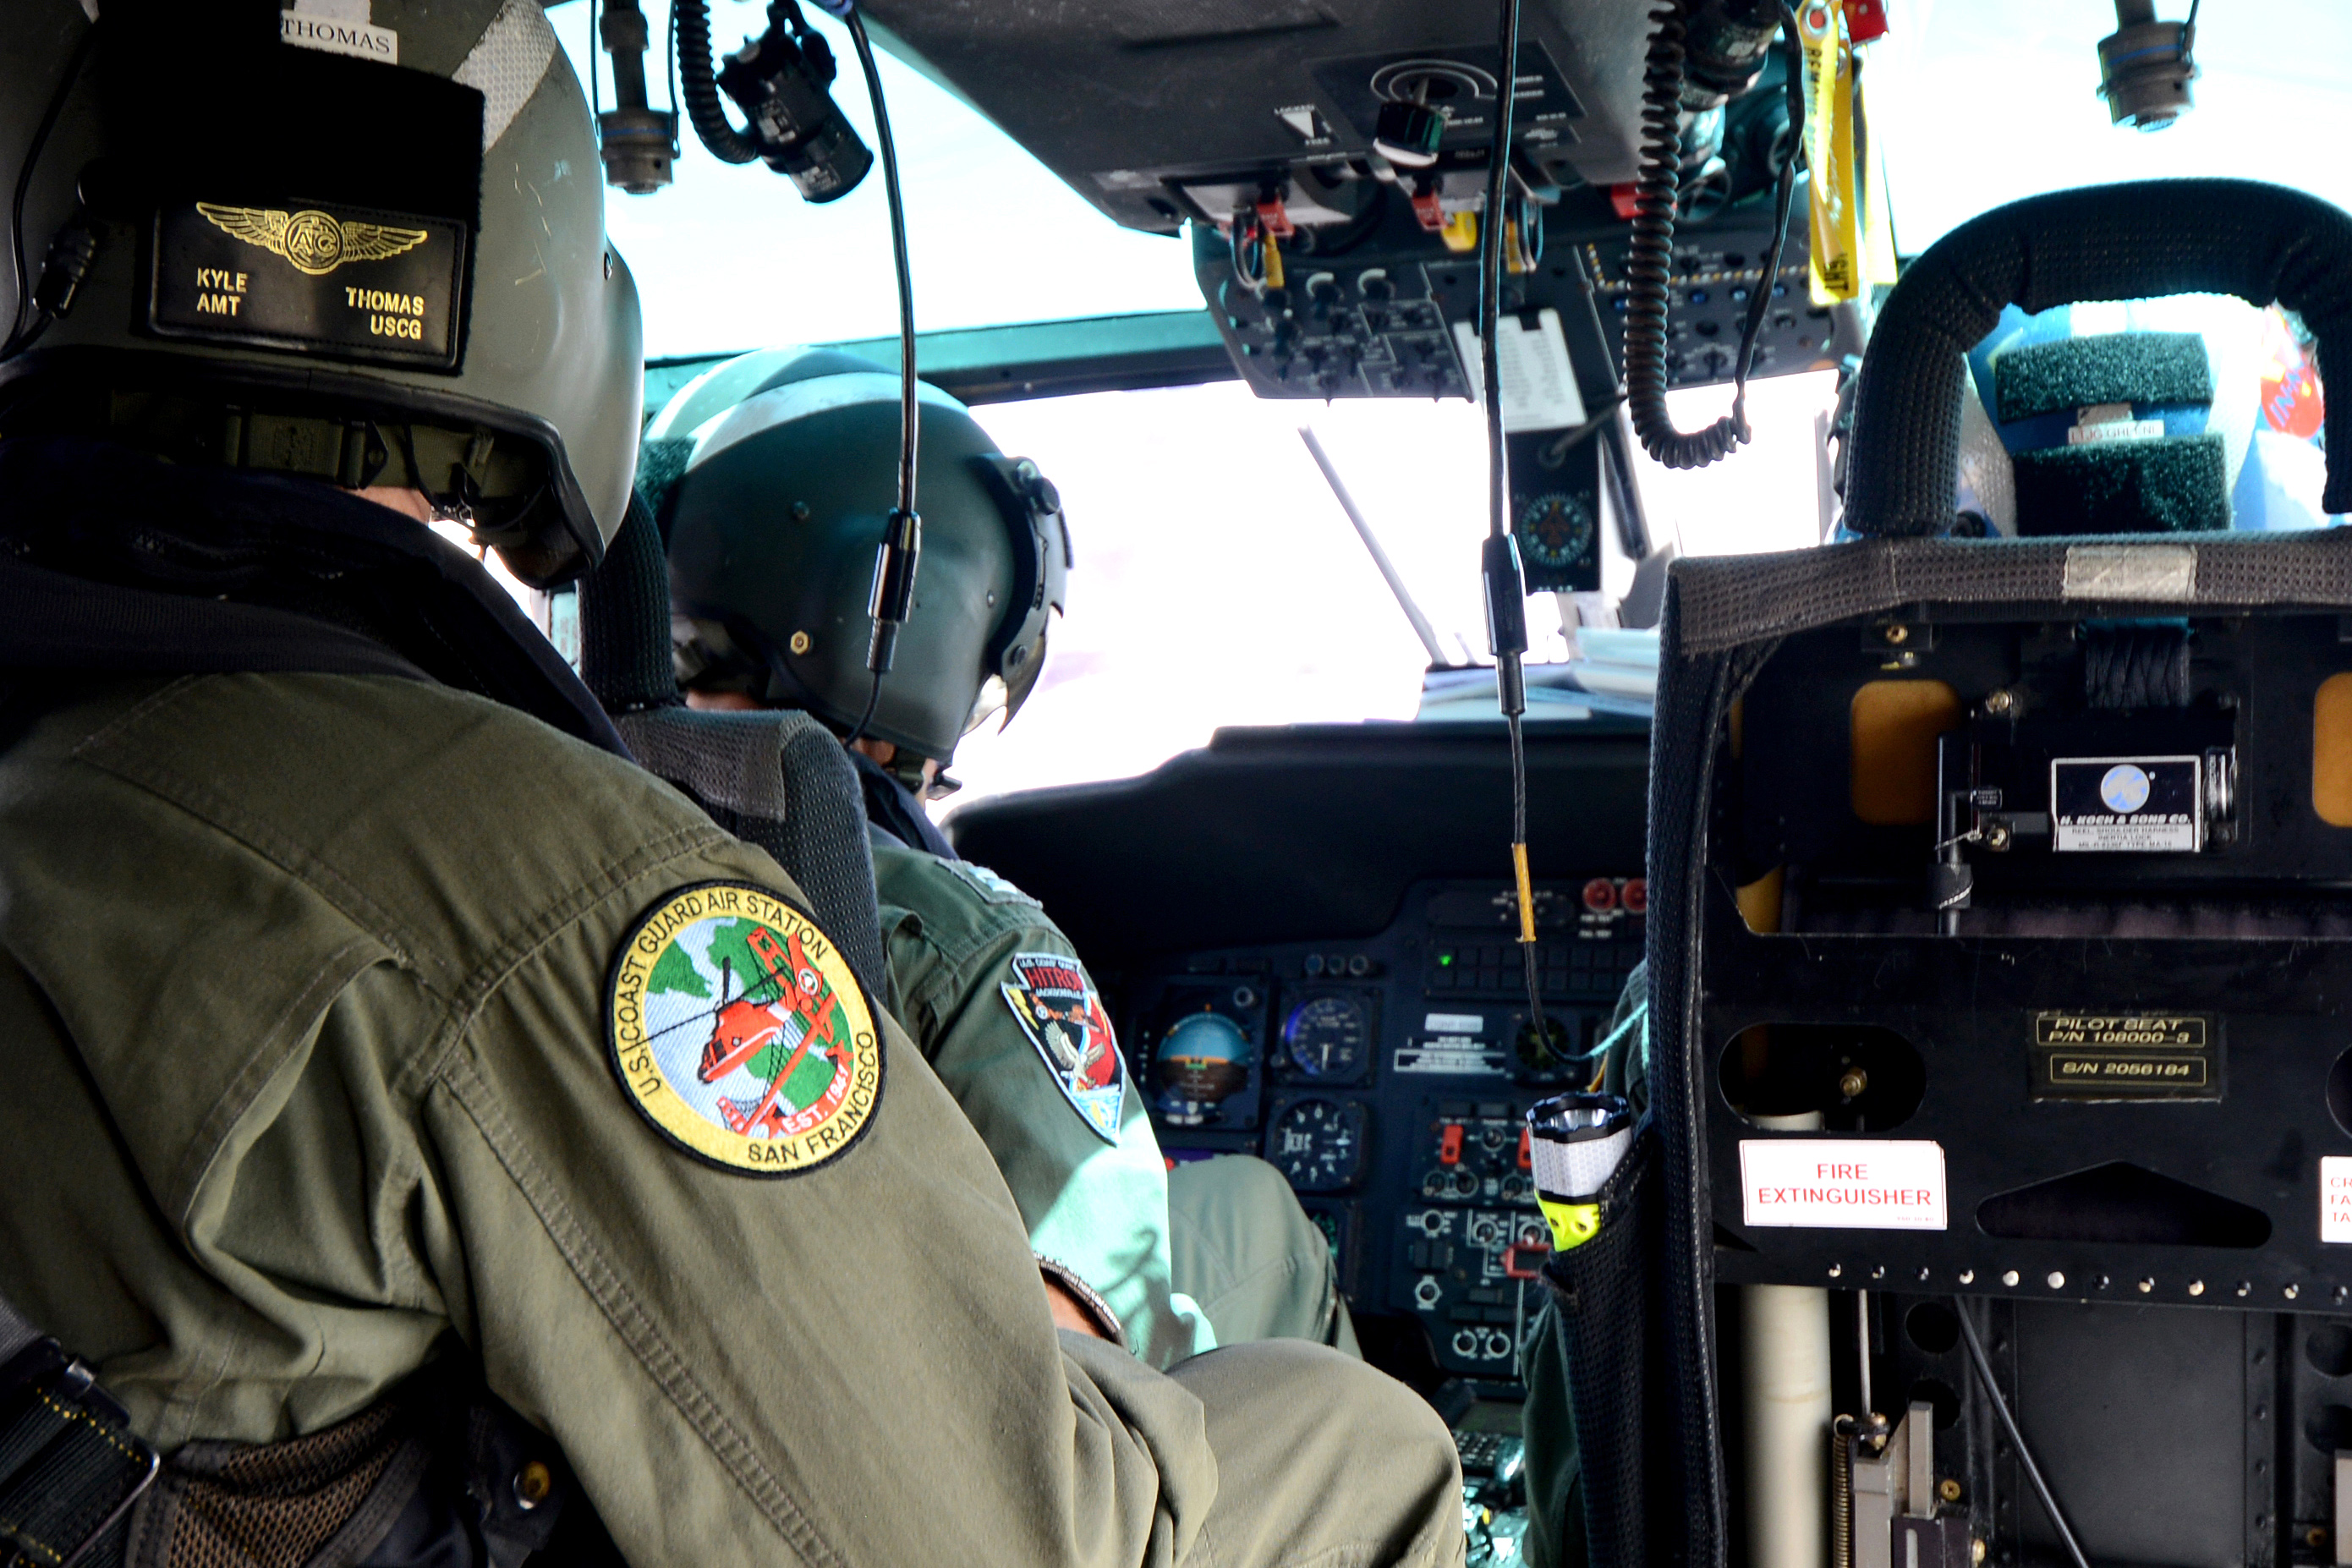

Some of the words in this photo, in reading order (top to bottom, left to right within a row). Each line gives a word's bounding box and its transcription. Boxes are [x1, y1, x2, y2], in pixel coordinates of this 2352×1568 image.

[282, 19, 390, 54] THOMAS
[197, 267, 248, 293] KYLE
[196, 293, 240, 316] AMT
[346, 286, 424, 316] THOMAS
[370, 314, 422, 340] USCG
[2076, 814, 2114, 825] KOCH
[2129, 814, 2167, 825] SONS
[618, 956, 644, 1044] COAST
[639, 896, 702, 954] GUARD
[708, 891, 740, 911] AIR
[747, 895, 828, 960] STATION
[2055, 1017, 2119, 1030] PILOT
[2124, 1017, 2183, 1031] SEAT
[2048, 1030, 2085, 1043] P/N
[2094, 1031, 2190, 1044] 108000-3
[2062, 1061, 2099, 1074] S/N
[748, 1142, 799, 1164] SAN
[806, 1031, 875, 1154] FRANCISCO
[782, 1105, 828, 1134] EST.
[826, 1064, 850, 1106] 1941
[1817, 1164, 1868, 1181] FIRE
[1758, 1187, 1932, 1206] EXTINGUISHER
